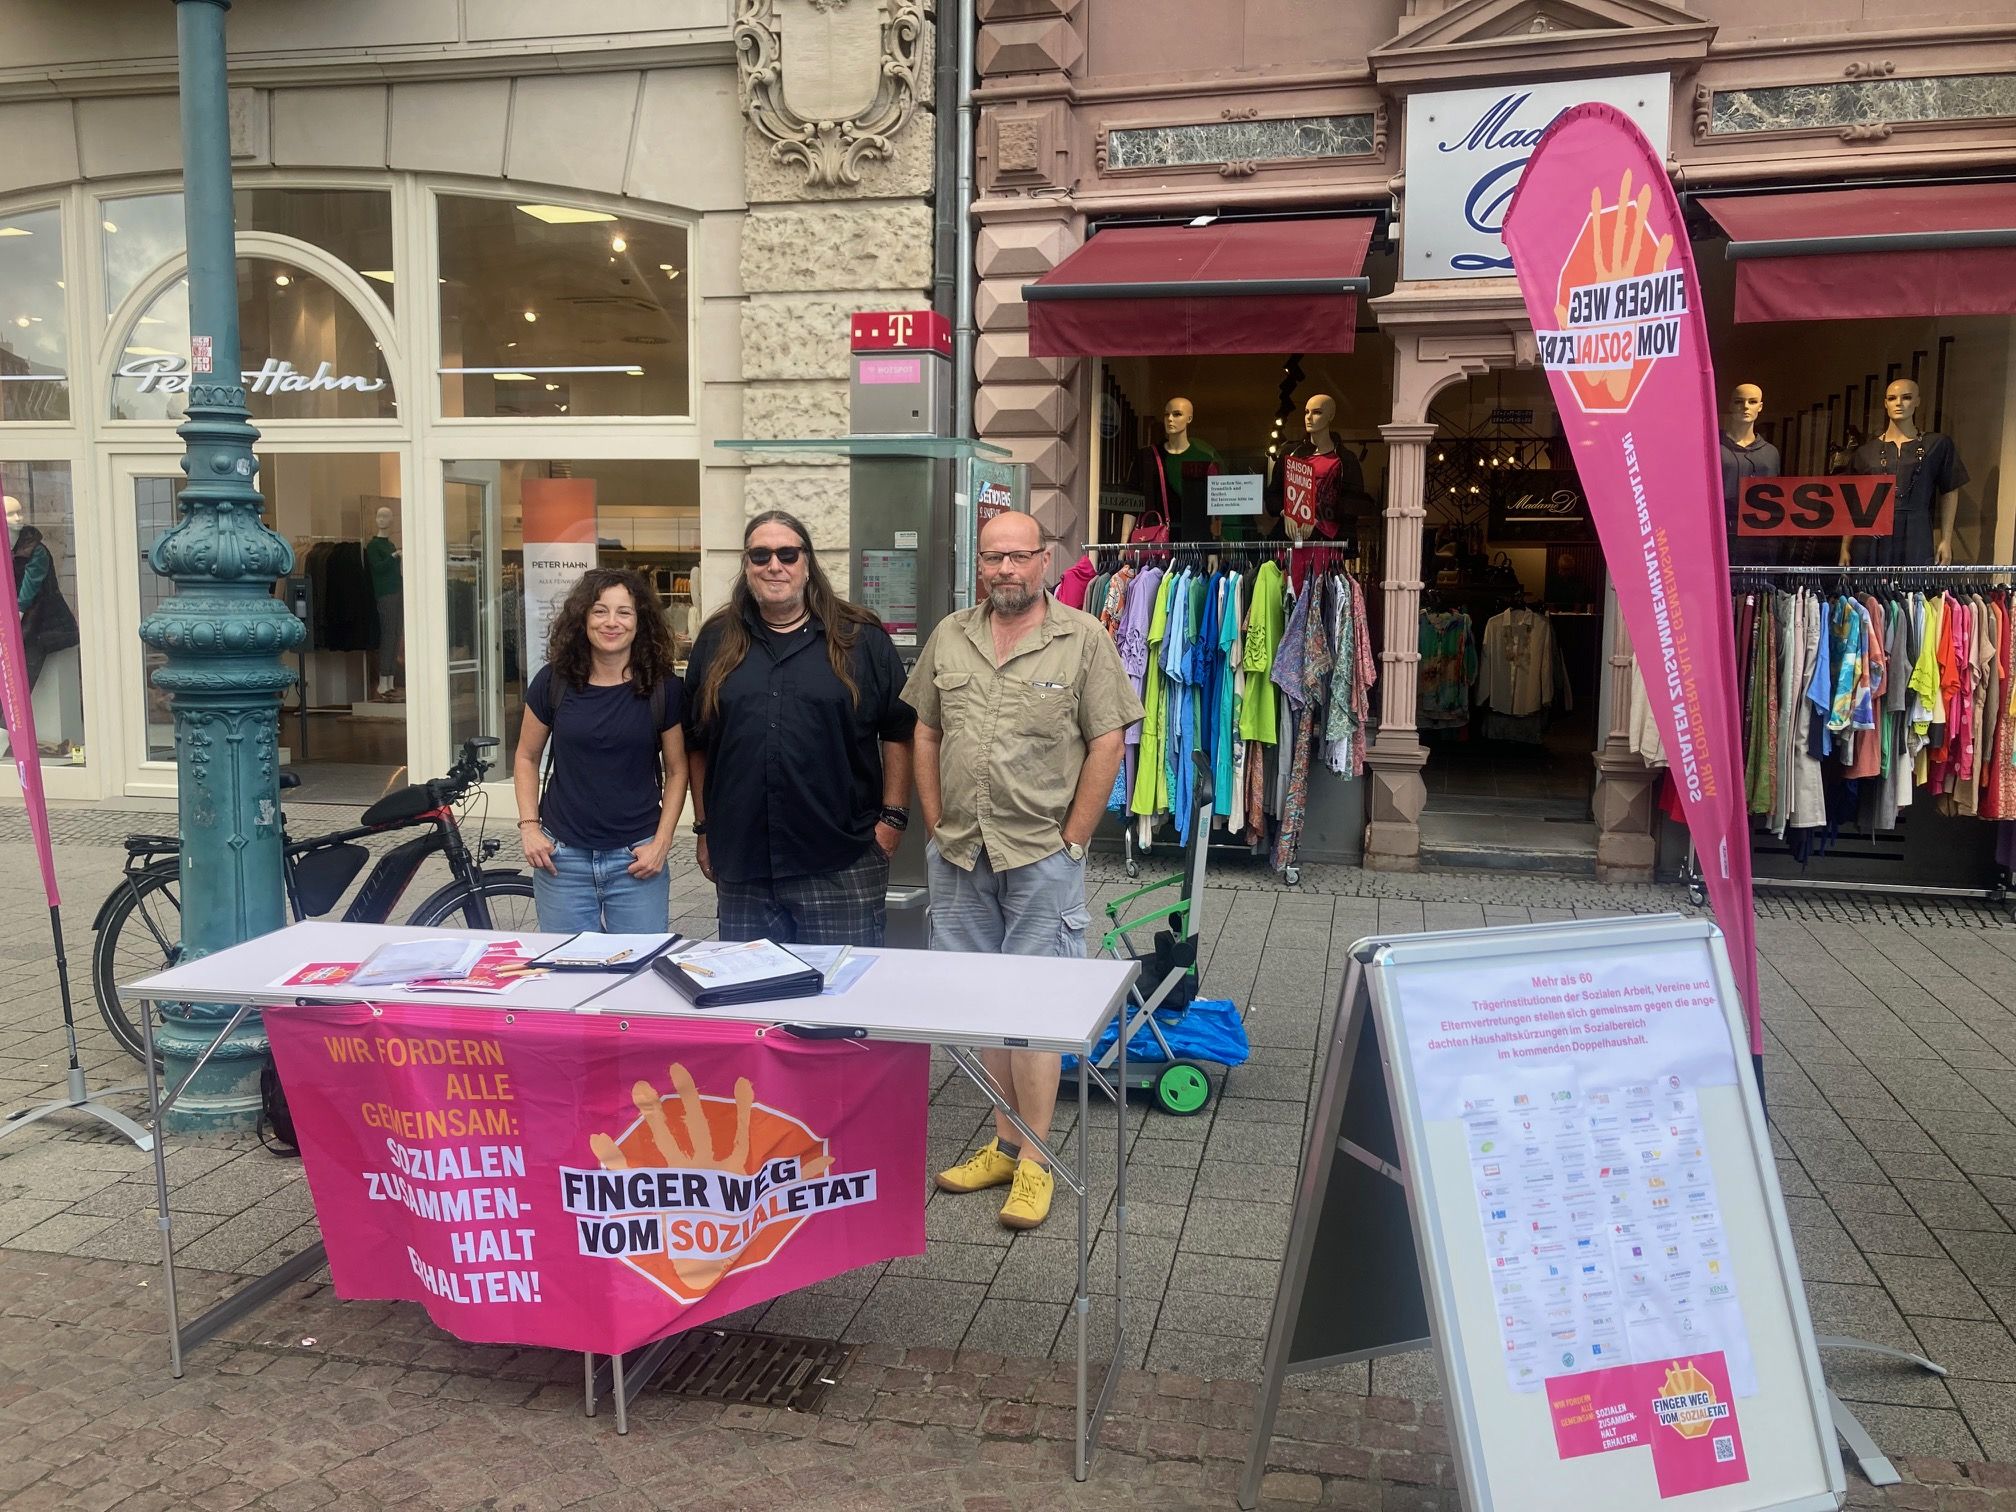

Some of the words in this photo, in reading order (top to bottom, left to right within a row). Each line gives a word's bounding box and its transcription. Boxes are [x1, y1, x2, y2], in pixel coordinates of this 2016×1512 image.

[888, 314, 913, 346] T
[248, 357, 387, 396] Hahn
[1286, 459, 1312, 476] SAISON
[1549, 489, 1579, 513] D
[1742, 483, 1893, 529] SSV
[532, 561, 561, 569] PETER
[562, 561, 588, 569] HAHN
[1472, 993, 1562, 1011] Trägerinstitutionen
[1563, 992, 1580, 1003] der
[1582, 988, 1621, 1000] Sozialen
[1623, 984, 1654, 997] Arbeit,
[1655, 981, 1691, 993] Vereine
[1693, 979, 1710, 990] und
[1531, 976, 1558, 988] Mehr
[1560, 974, 1577, 986] als
[1579, 972, 1593, 984] 60
[1440, 1015, 1532, 1032] Elternvertretungen
[1534, 1009, 1566, 1021] stellen
[1567, 1007, 1587, 1019] sich
[1590, 1003, 1642, 1018] gemeinsam
[1644, 999, 1673, 1013] gegen
[1674, 996, 1689, 1007] die
[1428, 1037, 1469, 1050] dachten
[1471, 1025, 1568, 1045] Haushaltskürzungen
[1584, 1018, 1647, 1033] Sozialbereich
[1513, 1042, 1572, 1058] kommenden
[1572, 1035, 1649, 1052] Doppelhaushalt.
[323, 1036, 375, 1063] WIR
[376, 1037, 505, 1067] FORDERN
[446, 1073, 514, 1100] ALLE
[361, 1102, 520, 1140] GEMEINSAM:
[386, 1137, 526, 1181] SOZIALEN
[362, 1172, 532, 1223] ZUSAMMEN-
[563, 1171, 711, 1212] FINGER
[717, 1158, 797, 1212] WEG
[579, 1218, 660, 1254] VOM
[670, 1174, 871, 1254] SOZIALETAT
[450, 1228, 536, 1264] HALT
[406, 1245, 543, 1304] ERHALTEN!
[1595, 1403, 1627, 1418] SOZIALEN
[1653, 1396, 1688, 1412] FINGER
[1688, 1392, 1709, 1407] WEG
[1660, 1412, 1679, 1425] VOM
[1680, 1404, 1727, 1422] SOZIALETAT
[1598, 1412, 1637, 1429] ZUSAMMEN-
[1600, 1427, 1617, 1439] HALT
[1603, 1433, 1639, 1450] ERHALTEN!
